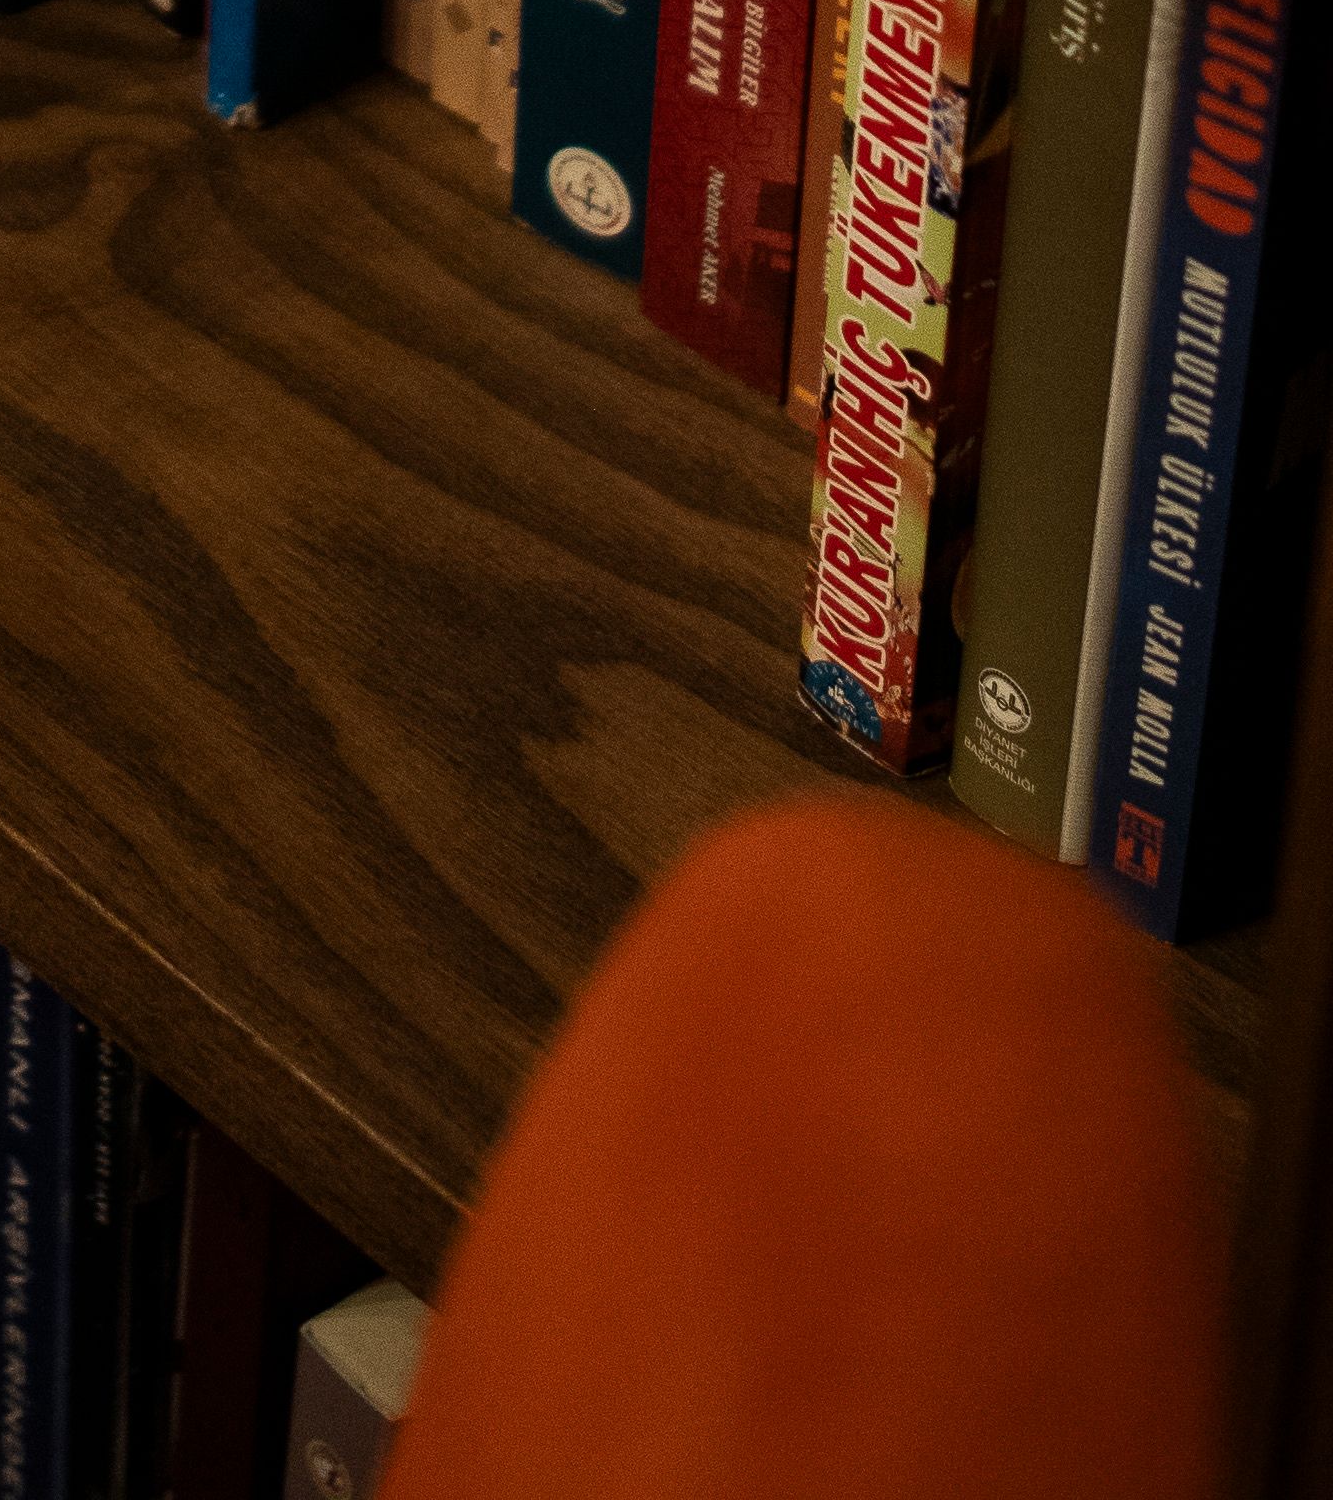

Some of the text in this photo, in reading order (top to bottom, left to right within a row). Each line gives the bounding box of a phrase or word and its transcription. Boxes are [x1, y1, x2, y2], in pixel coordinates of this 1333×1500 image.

[698, 164, 727, 251] Mehmet
[822, 318, 934, 459] HİÇ
[1162, 256, 1231, 453] MUTLULUK
[813, 429, 906, 695] KUR'AN
[1146, 453, 1217, 591] ÜLKESİ
[1141, 603, 1186, 688] JEAN
[1127, 686, 1176, 789] MOLLA
